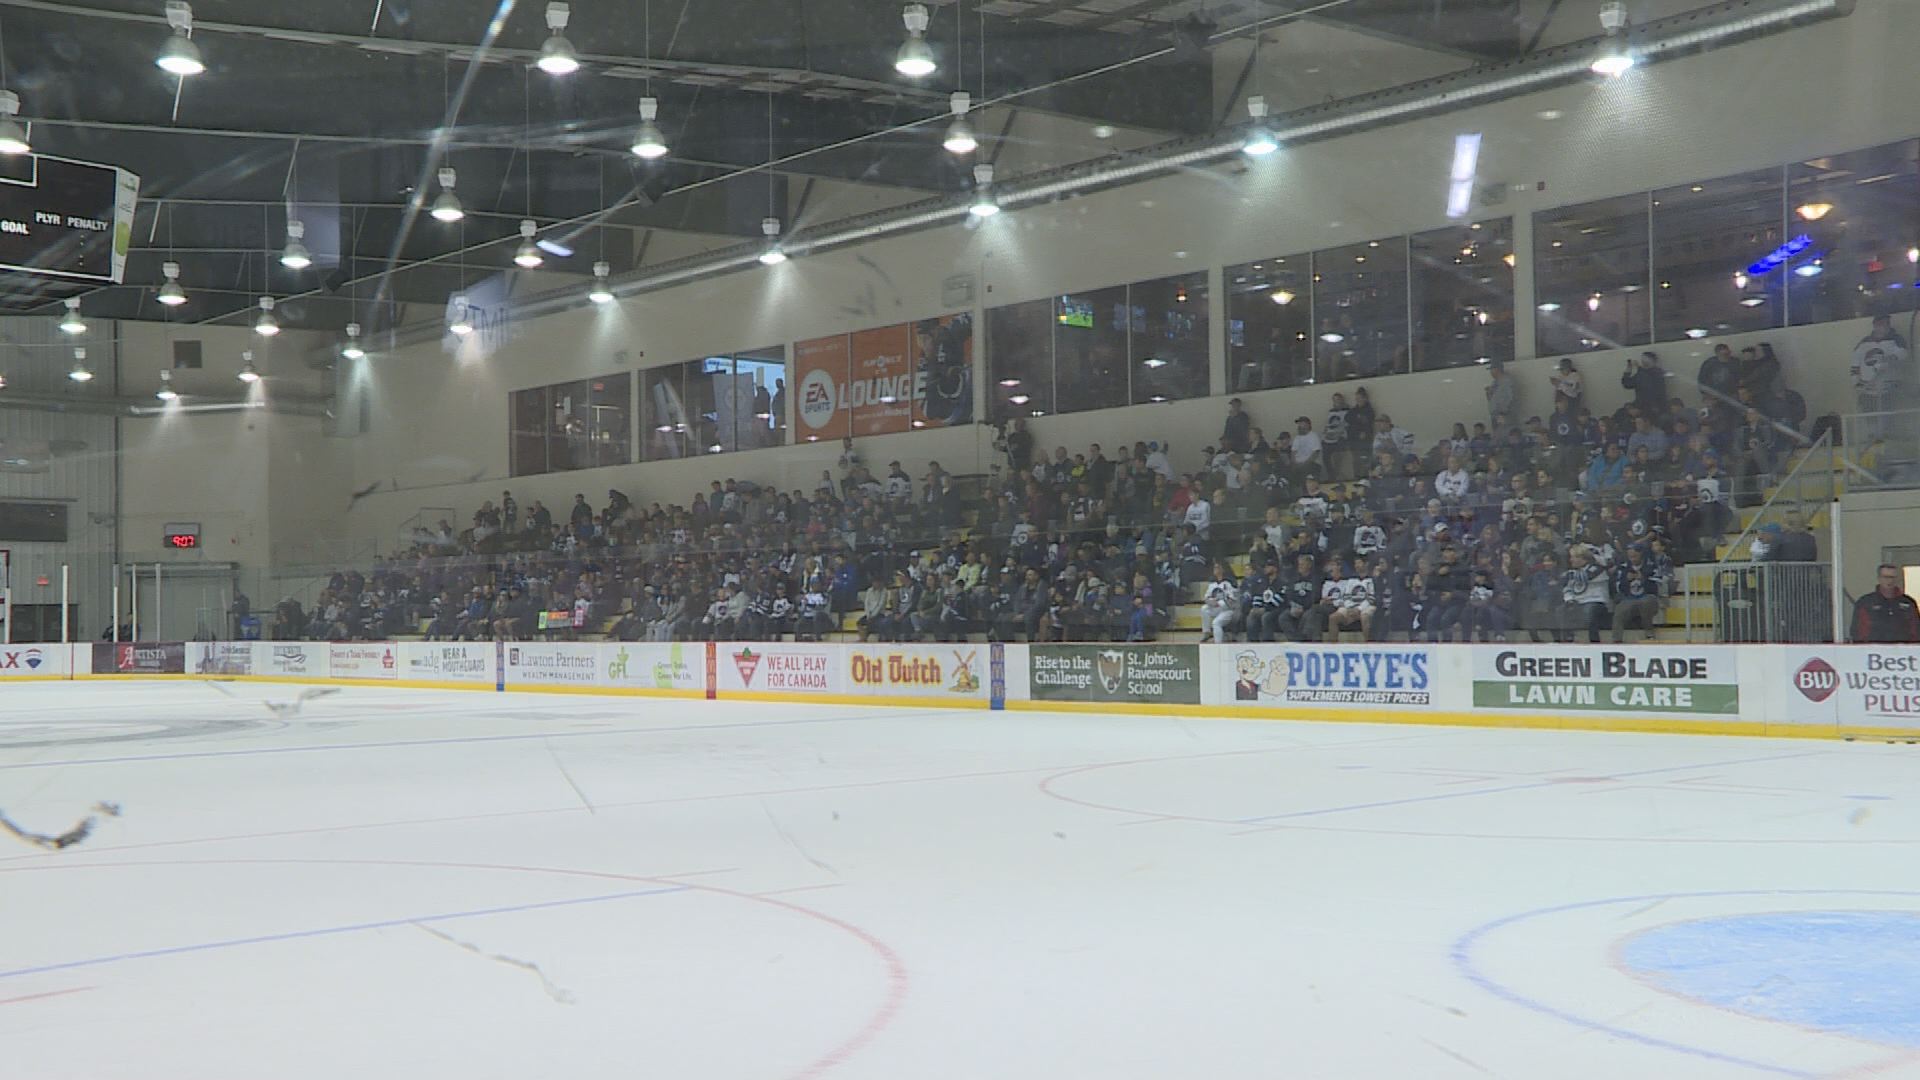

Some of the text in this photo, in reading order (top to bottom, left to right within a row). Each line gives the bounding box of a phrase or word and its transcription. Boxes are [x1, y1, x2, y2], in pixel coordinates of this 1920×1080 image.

[0, 220, 29, 235] GOAL
[35, 211, 109, 231] PLYR PENALTY
[806, 382, 828, 403] EA
[837, 371, 929, 409] LOUNGE
[804, 401, 831, 414] SPORTS
[520, 652, 595, 669] Lawton Partners
[767, 655, 784, 670] WE
[784, 655, 801, 670] ALL
[803, 656, 828, 671] PLAY
[1035, 656, 1092, 670] Rise to the
[1127, 651, 1179, 667] St. John's-
[1495, 650, 1708, 680] GREEN BLADE
[1867, 653, 1917, 672] Best
[522, 671, 595, 681] WEALTH MANAGEMENT
[608, 661, 630, 680] GFL
[851, 654, 942, 684] Old Dutch
[1127, 667, 1192, 681] Ravenscourt
[1285, 651, 1428, 690] POPEYE'S
[767, 673, 828, 689] FOR CANADA
[1035, 670, 1092, 688] Challenge
[1799, 672, 1836, 690] BW
[1845, 671, 1920, 691] Wester
[1127, 682, 1163, 695] School
[1288, 691, 1429, 704] SUPPLEMENTS LOWEST PRICES
[1509, 684, 1694, 708] LAWN CARE
[1864, 693, 1920, 713] PLUS
